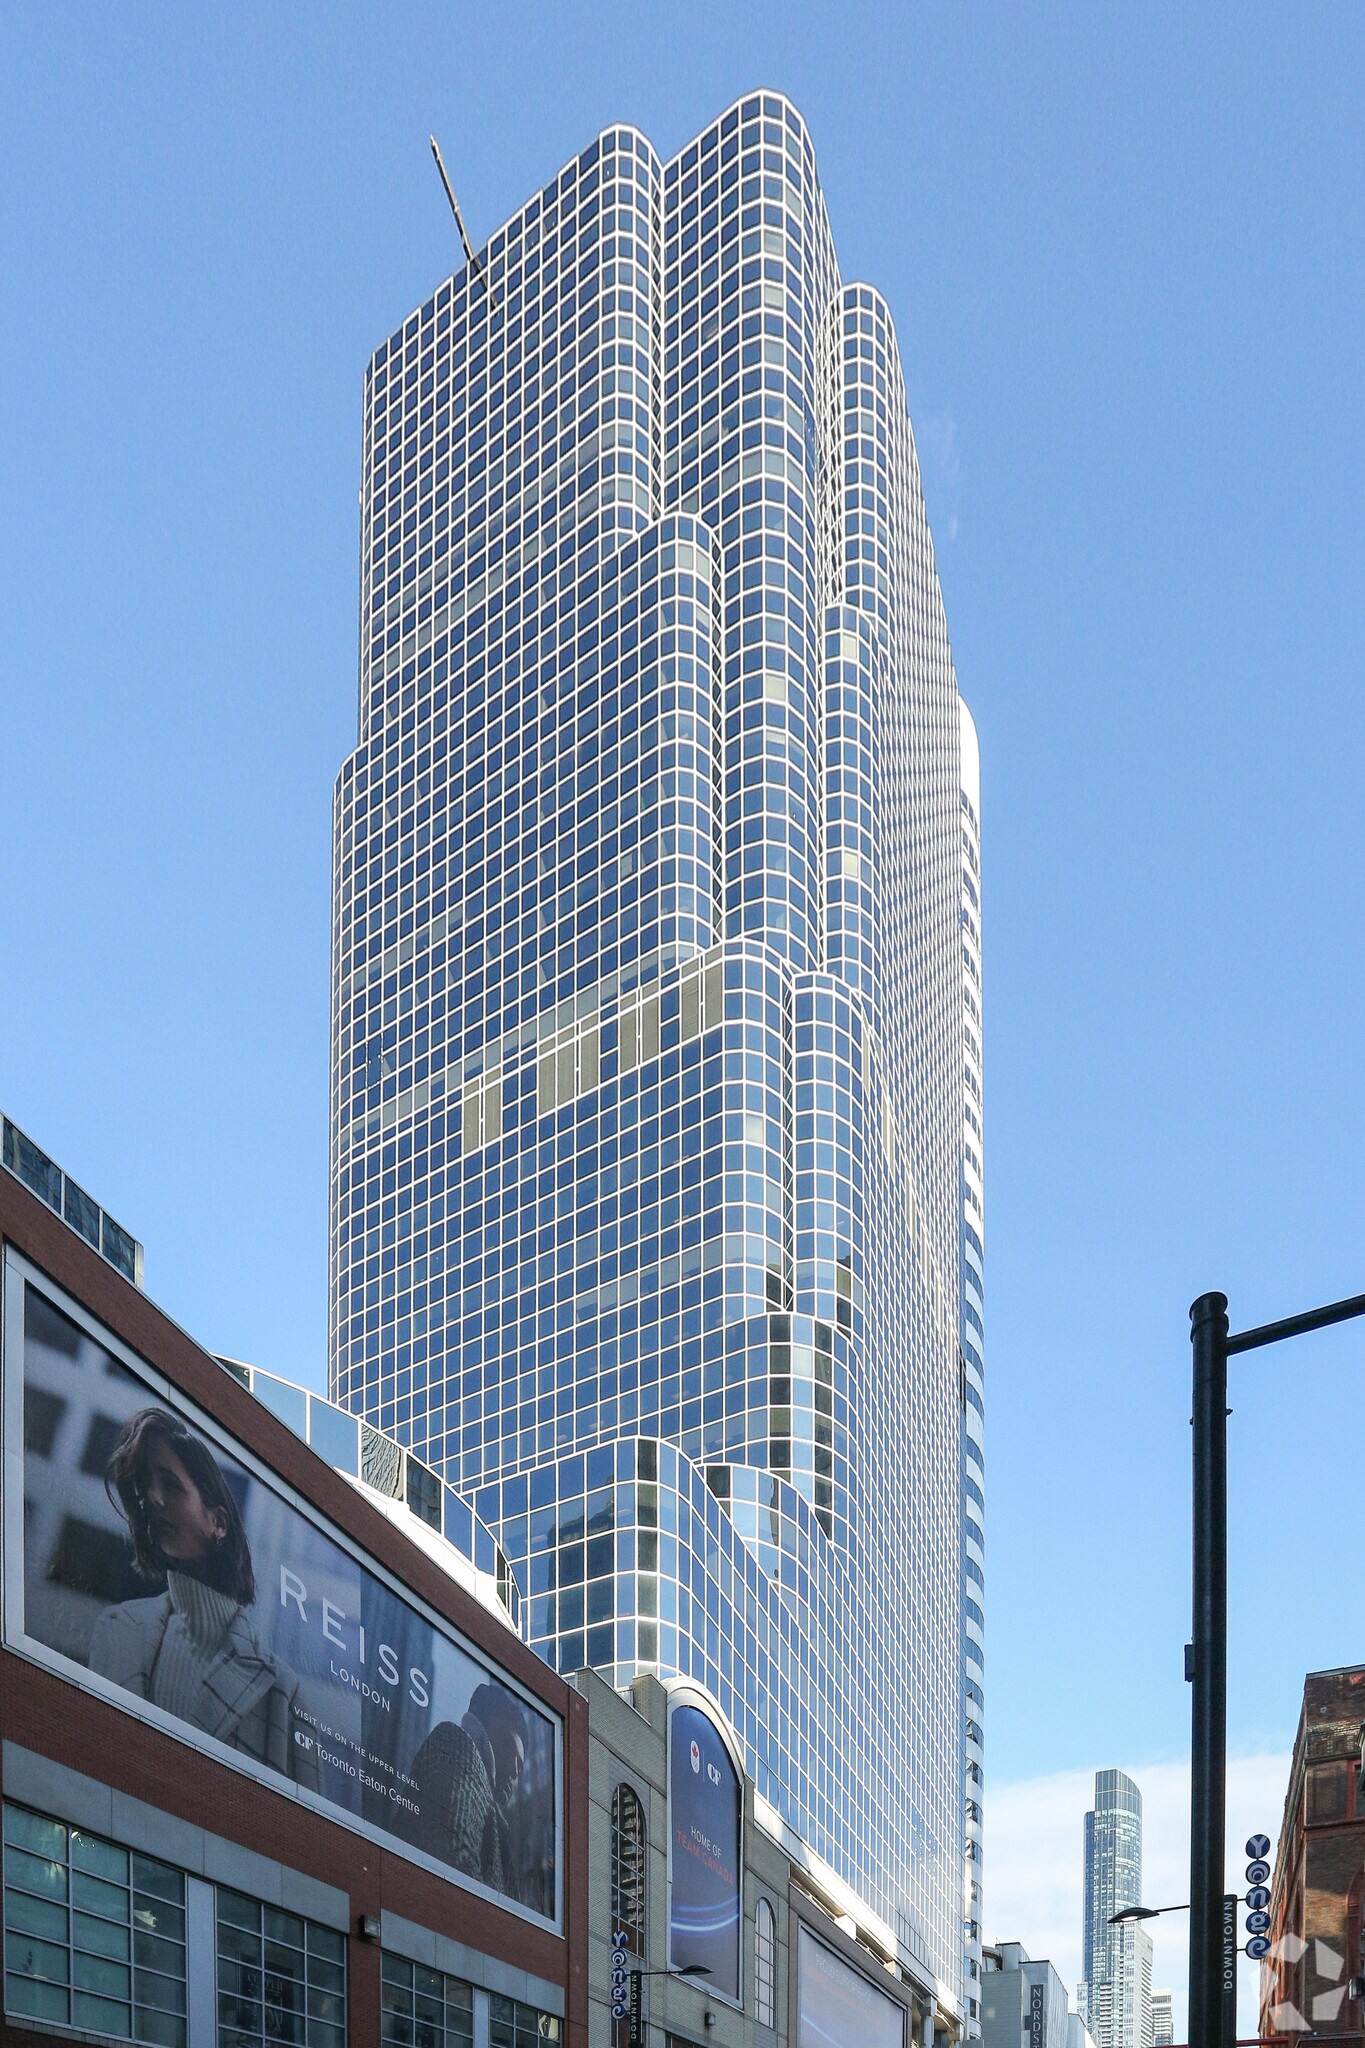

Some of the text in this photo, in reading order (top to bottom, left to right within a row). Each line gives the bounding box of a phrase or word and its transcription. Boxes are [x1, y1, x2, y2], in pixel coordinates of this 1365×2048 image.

[280, 1564, 429, 1708] REISS
[330, 1660, 390, 1712] LONDON
[294, 1706, 420, 1791] VISIT US ON THE UPPER LEVEL
[294, 1731, 420, 1815] CF Toronto Eaton Centre
[707, 1762, 722, 1786] CF
[676, 1829, 734, 1885] TEAM CANADA
[690, 1826, 722, 1858] HOME OF
[1223, 1901, 1234, 1989] DOWNTOWN
[630, 1975, 638, 2039] DOWNTOWN
[1032, 1988, 1042, 2048] NORDS
